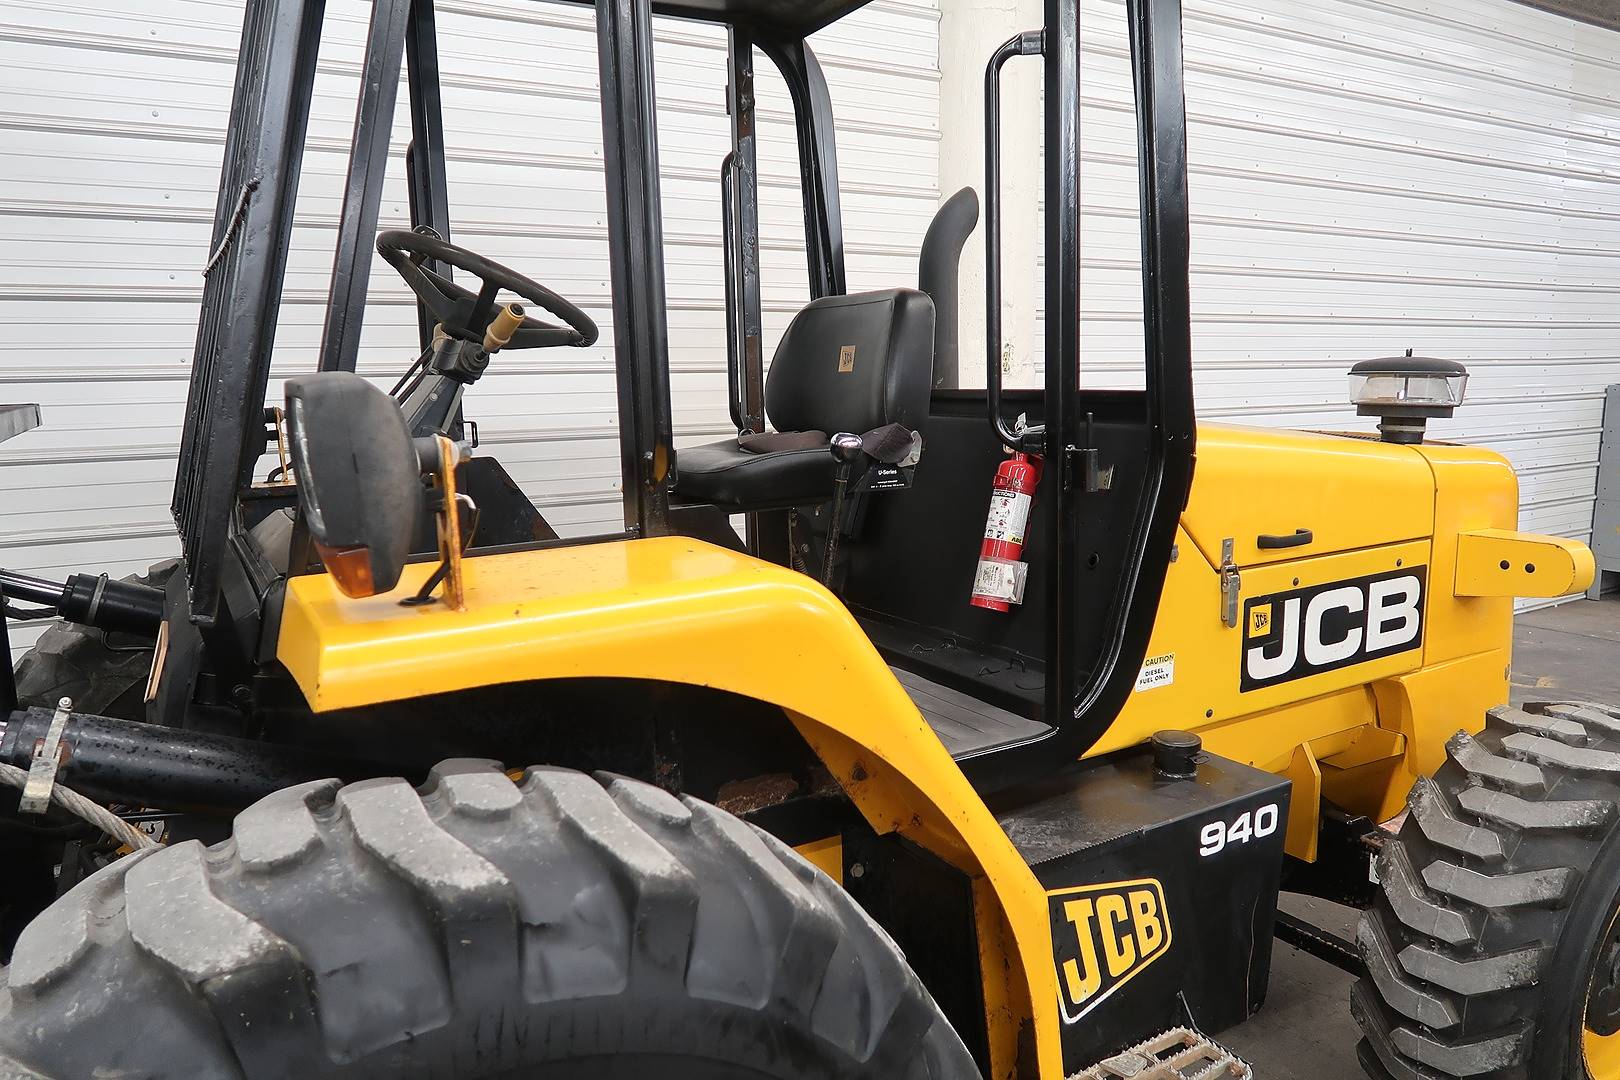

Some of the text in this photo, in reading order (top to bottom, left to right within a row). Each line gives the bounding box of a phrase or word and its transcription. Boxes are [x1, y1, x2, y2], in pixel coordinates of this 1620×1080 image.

[1247, 575, 1421, 680] JCB
[1255, 613, 1268, 629] JCB
[1145, 653, 1175, 667] CAUTION
[1139, 672, 1170, 685] FUEL ONLY
[1145, 667, 1164, 677] DIESEL
[1199, 803, 1279, 857] 940
[1062, 889, 1163, 1005] JCB
